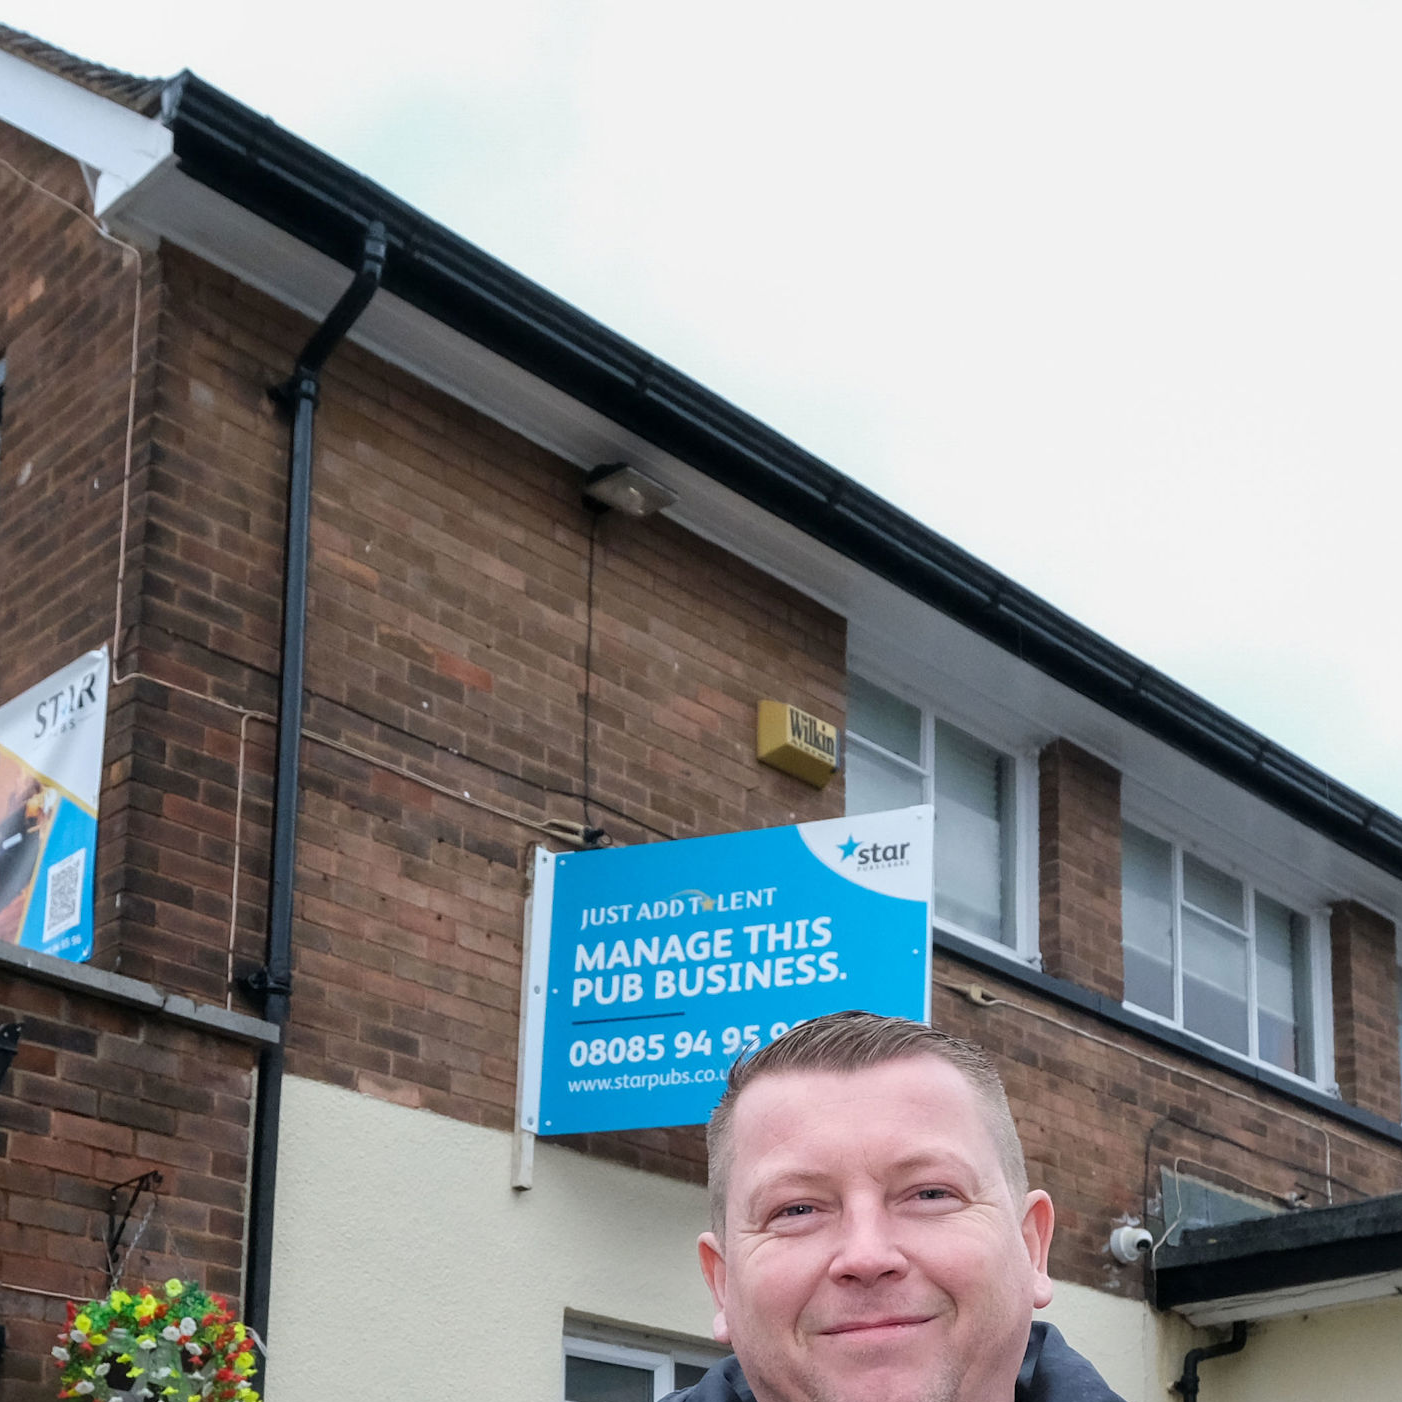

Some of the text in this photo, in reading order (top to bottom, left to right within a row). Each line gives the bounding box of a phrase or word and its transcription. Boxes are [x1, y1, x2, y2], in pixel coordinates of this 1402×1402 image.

[790, 707, 835, 757] Wilkin
[858, 842, 910, 865] star
[580, 887, 778, 931] JUST ADD TLENT
[574, 916, 833, 973] MANAGE THIS
[572, 951, 848, 1008] PUB BUSINESS.
[569, 1034, 666, 1068] 08085
[674, 1030, 712, 1059] 94
[721, 1025, 761, 1055] 95
